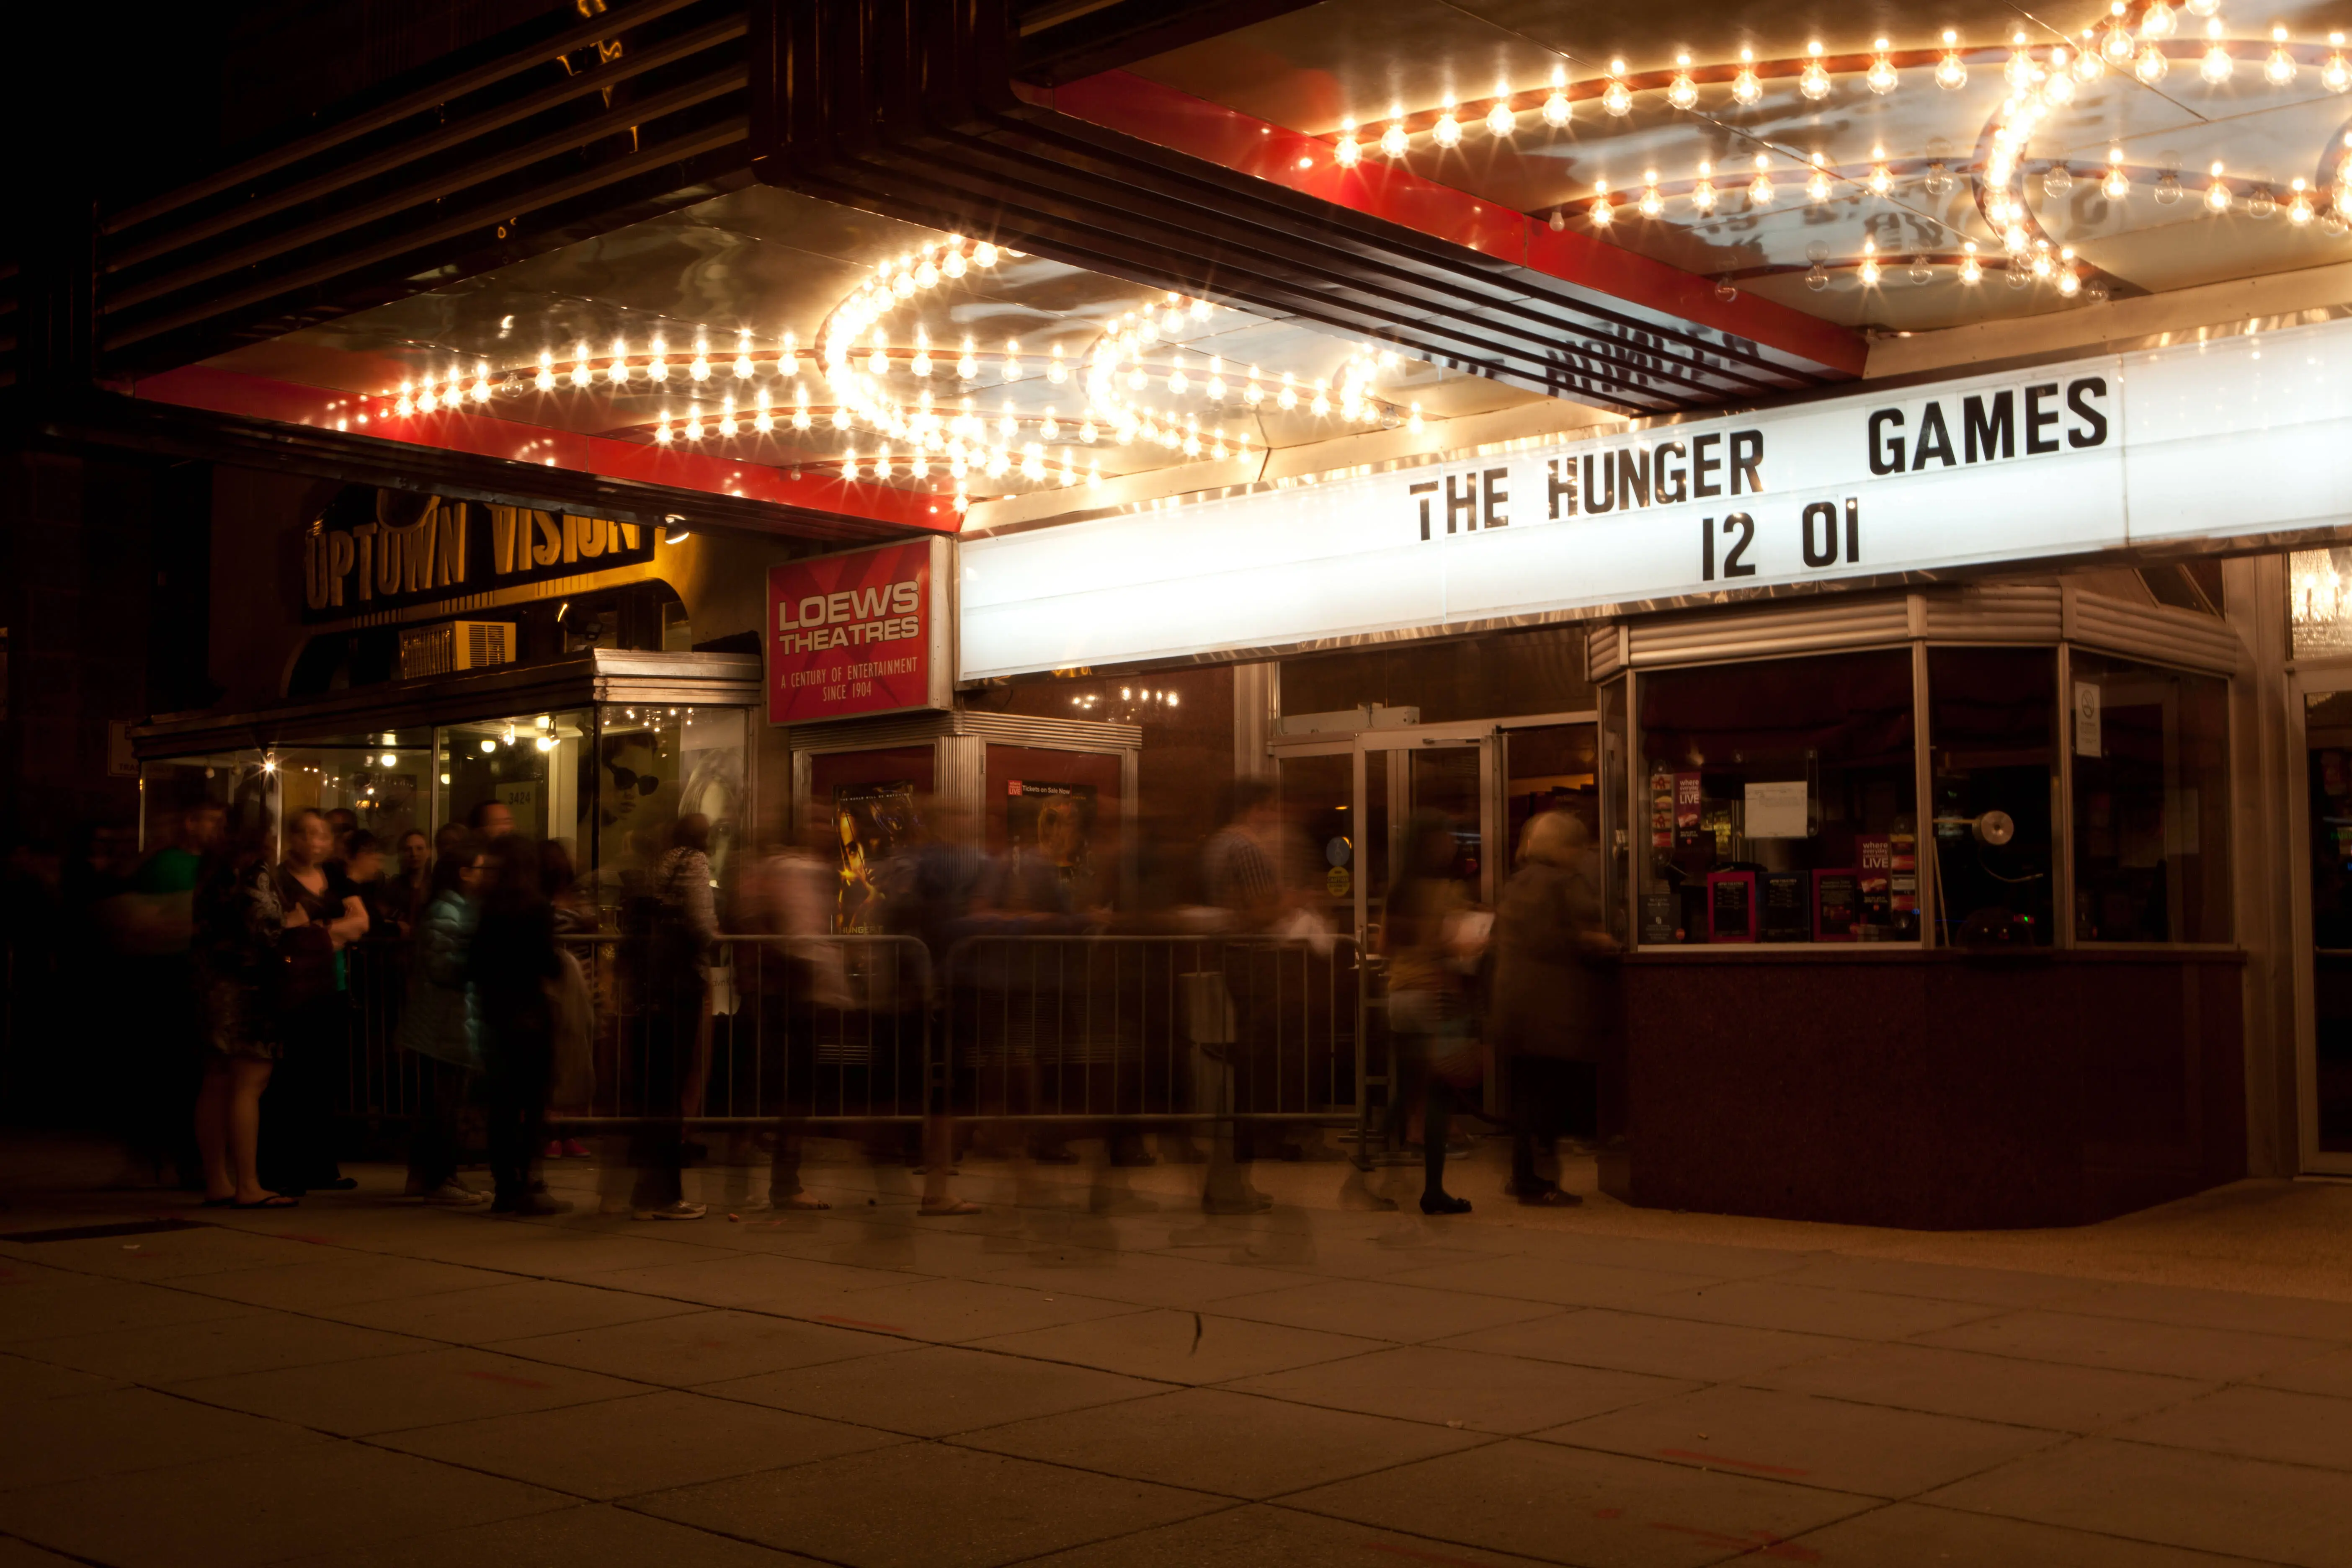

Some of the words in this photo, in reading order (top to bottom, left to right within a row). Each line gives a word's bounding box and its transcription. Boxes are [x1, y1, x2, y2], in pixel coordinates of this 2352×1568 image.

[1410, 467, 1509, 541] THE
[1548, 429, 1764, 520] HUNGER
[1868, 376, 2107, 476] GAMES
[305, 502, 467, 610] UPTOWN
[483, 503, 640, 575] VISION
[1702, 512, 1756, 581] 12
[779, 580, 919, 632] LOEWS
[779, 616, 919, 655] THEATRES
[781, 675, 786, 689] A
[791, 669, 826, 688] CENTURY
[831, 667, 842, 681] OF
[848, 657, 918, 680] ENTERTAINMENT
[823, 685, 846, 702] SINCE
[852, 681, 872, 698] 1904
[508, 790, 531, 805] 3424
[1680, 794, 1700, 804] LIVE
[1863, 858, 1888, 869] LIVE
